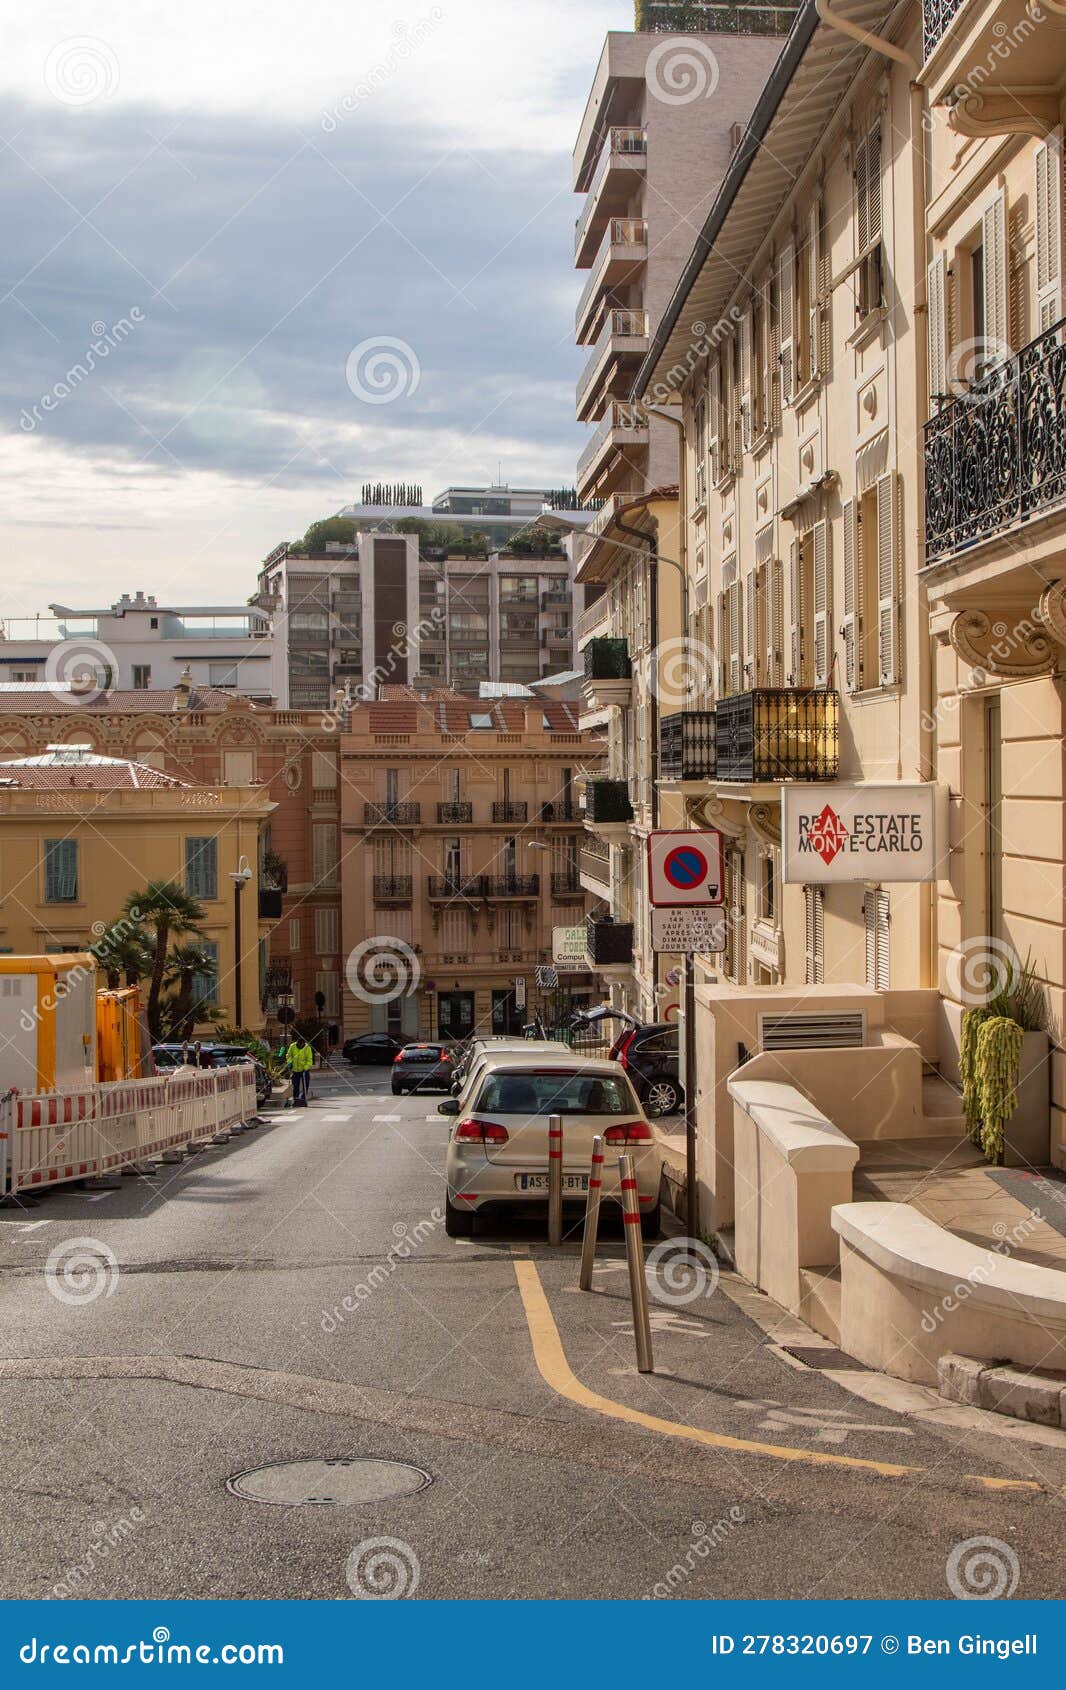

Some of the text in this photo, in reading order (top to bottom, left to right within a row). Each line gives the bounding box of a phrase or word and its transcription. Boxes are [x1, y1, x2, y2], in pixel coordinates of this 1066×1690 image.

[799, 815, 921, 834] REAL ESTATE
[798, 834, 923, 852] MONTE-CARLO
